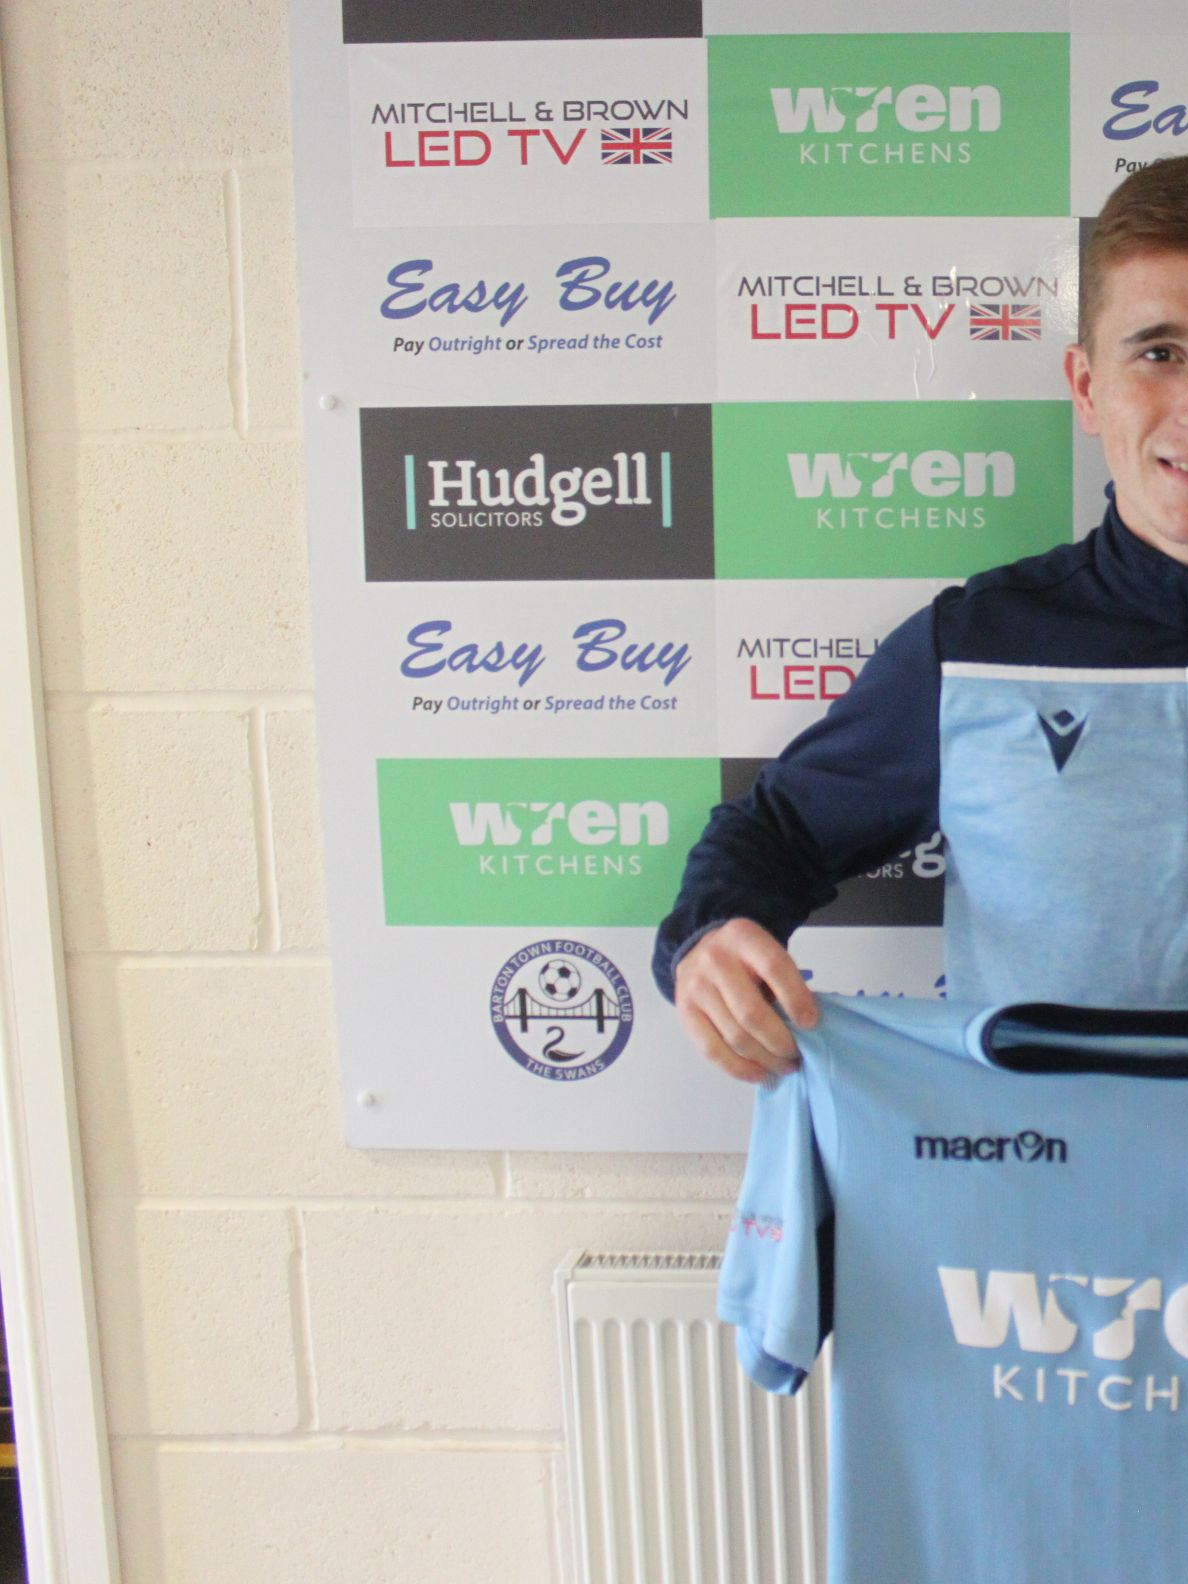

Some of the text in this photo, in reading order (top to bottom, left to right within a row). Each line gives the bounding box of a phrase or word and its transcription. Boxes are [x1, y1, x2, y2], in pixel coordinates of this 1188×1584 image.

[371, 99, 689, 125] MITCHELL & BROWN
[769, 83, 1002, 134] wren
[384, 128, 587, 167] LED TV
[799, 141, 973, 166] KITCHENS
[380, 256, 678, 327] Easy Buy
[737, 276, 1060, 298] MITCHELL & BROWN
[750, 304, 956, 341] LED TV
[393, 333, 663, 355] Pay Outright or Spread the Cost
[428, 452, 652, 526] Hudgell
[787, 449, 1016, 499] wren
[431, 511, 544, 528] SOLICITORS
[816, 506, 986, 530] KITCHENS
[400, 619, 692, 688] Easy Buy
[413, 695, 678, 714] Pay Outright or Spread the Cost
[449, 799, 669, 847] wren
[480, 855, 642, 876] KITCHENS
[492, 941, 632, 1023] BARTON TOWN FOOTBALL CLUB
[525, 1059, 605, 1080] THE SWANS
[914, 1129, 1068, 1163] macron
